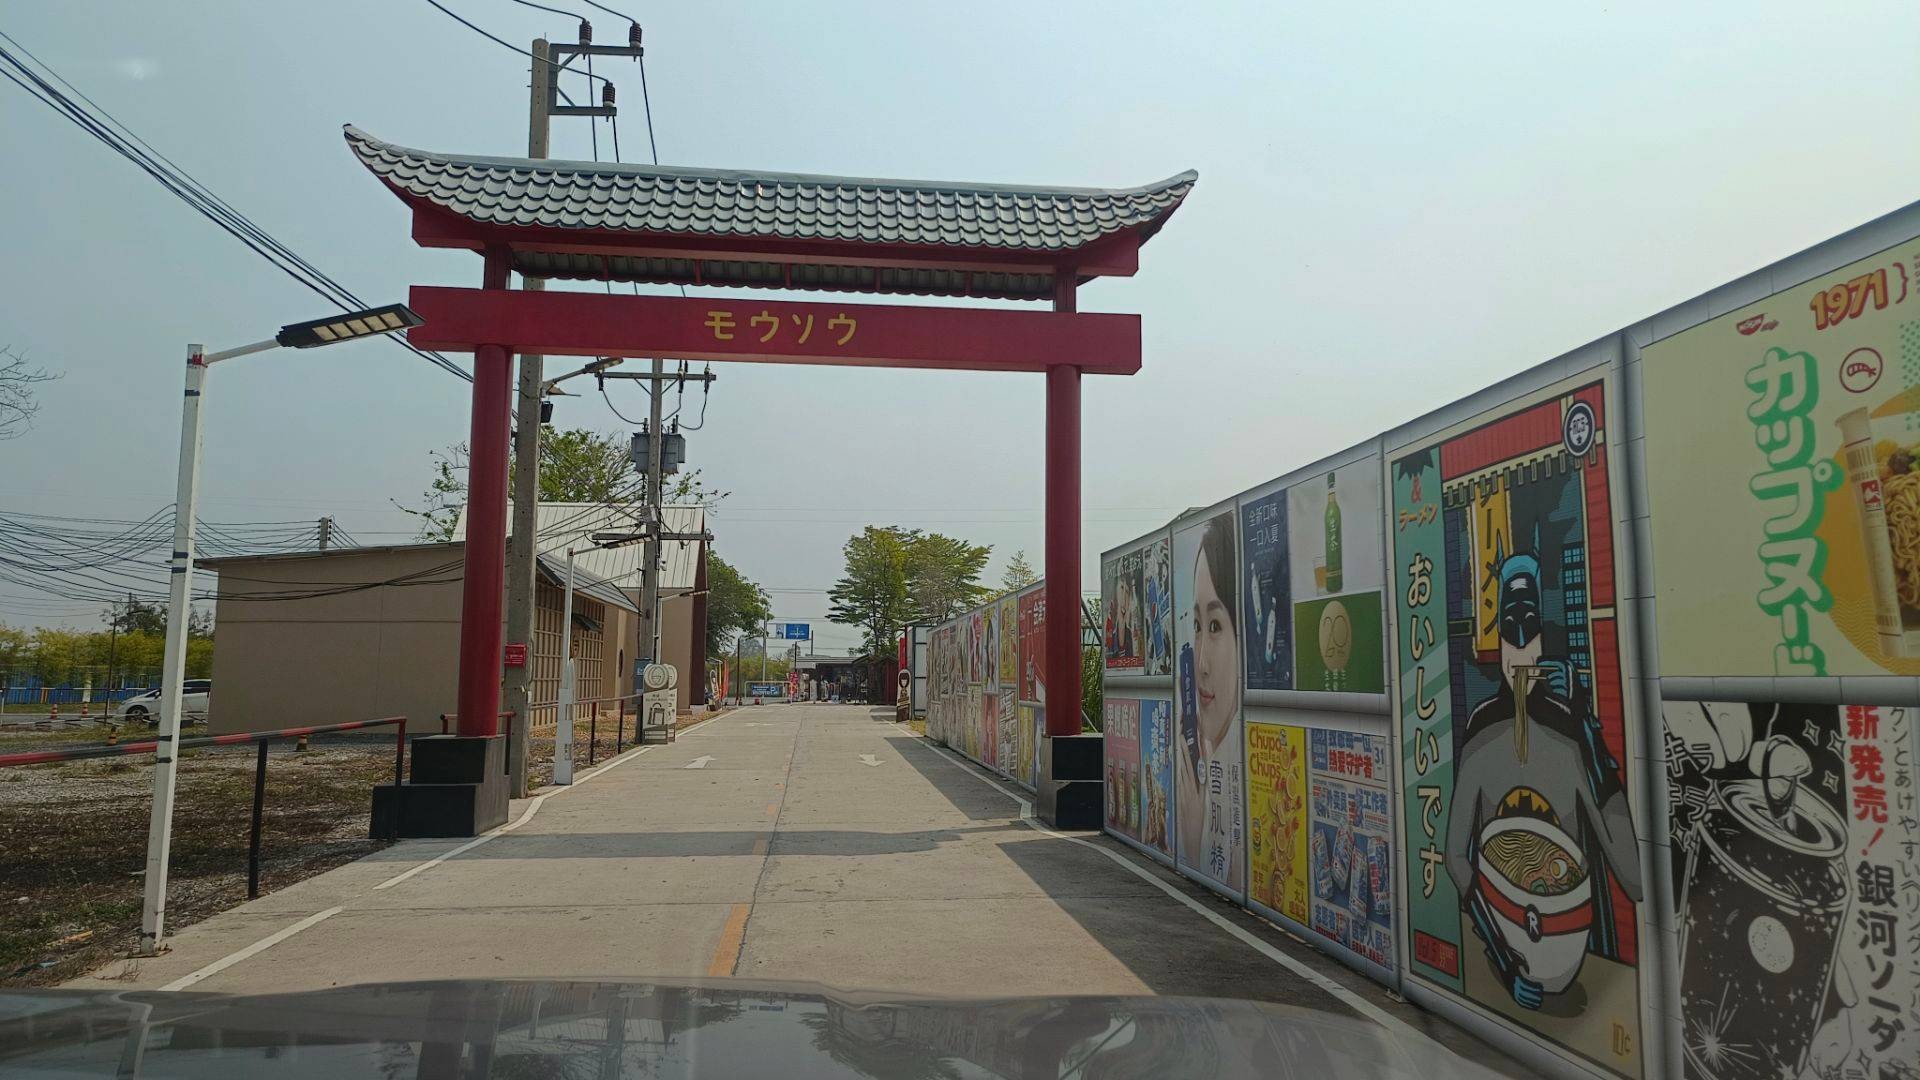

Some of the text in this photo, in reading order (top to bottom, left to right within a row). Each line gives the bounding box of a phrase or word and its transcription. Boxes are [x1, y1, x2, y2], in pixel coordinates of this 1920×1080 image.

[1809, 265, 1890, 331] 1971
[704, 310, 857, 346] モウソウ
[1399, 504, 1438, 531] ラーメン
[1407, 553, 1444, 899] おいしいです
[1527, 909, 1539, 933] R
